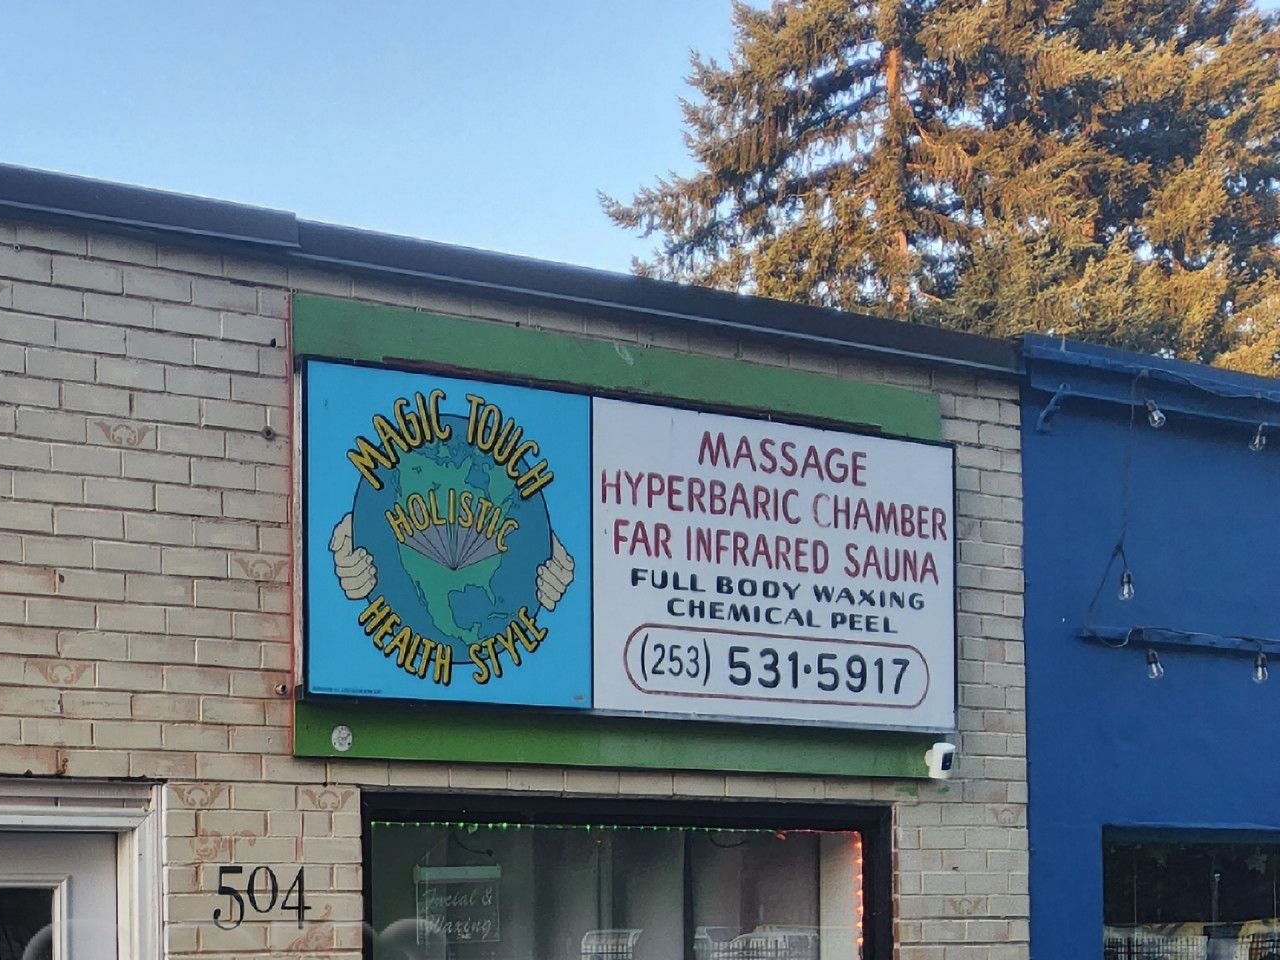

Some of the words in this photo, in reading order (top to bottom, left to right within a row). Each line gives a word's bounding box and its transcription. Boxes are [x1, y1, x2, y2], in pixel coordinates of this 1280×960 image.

[346, 388, 452, 491] MAGIC
[466, 392, 554, 499] TOUCH
[698, 430, 867, 486] MASSAGE
[384, 488, 519, 553] HOLISTIC
[601, 469, 801, 525] HYPERBARIC
[812, 492, 947, 541] CHAMBER
[613, 518, 672, 559] FAR
[686, 525, 829, 574] INFRARED
[844, 542, 939, 586] SAUNA
[631, 567, 706, 593] FULL
[716, 575, 801, 601] BODY
[813, 583, 925, 610] WAXING
[667, 597, 821, 628] CHEMICAL
[830, 611, 899, 634] PEEL
[358, 595, 452, 686] HEALTH
[469, 605, 549, 685] STYLE
[640, 632, 711, 687] (253)
[213, 865, 312, 931] 504
